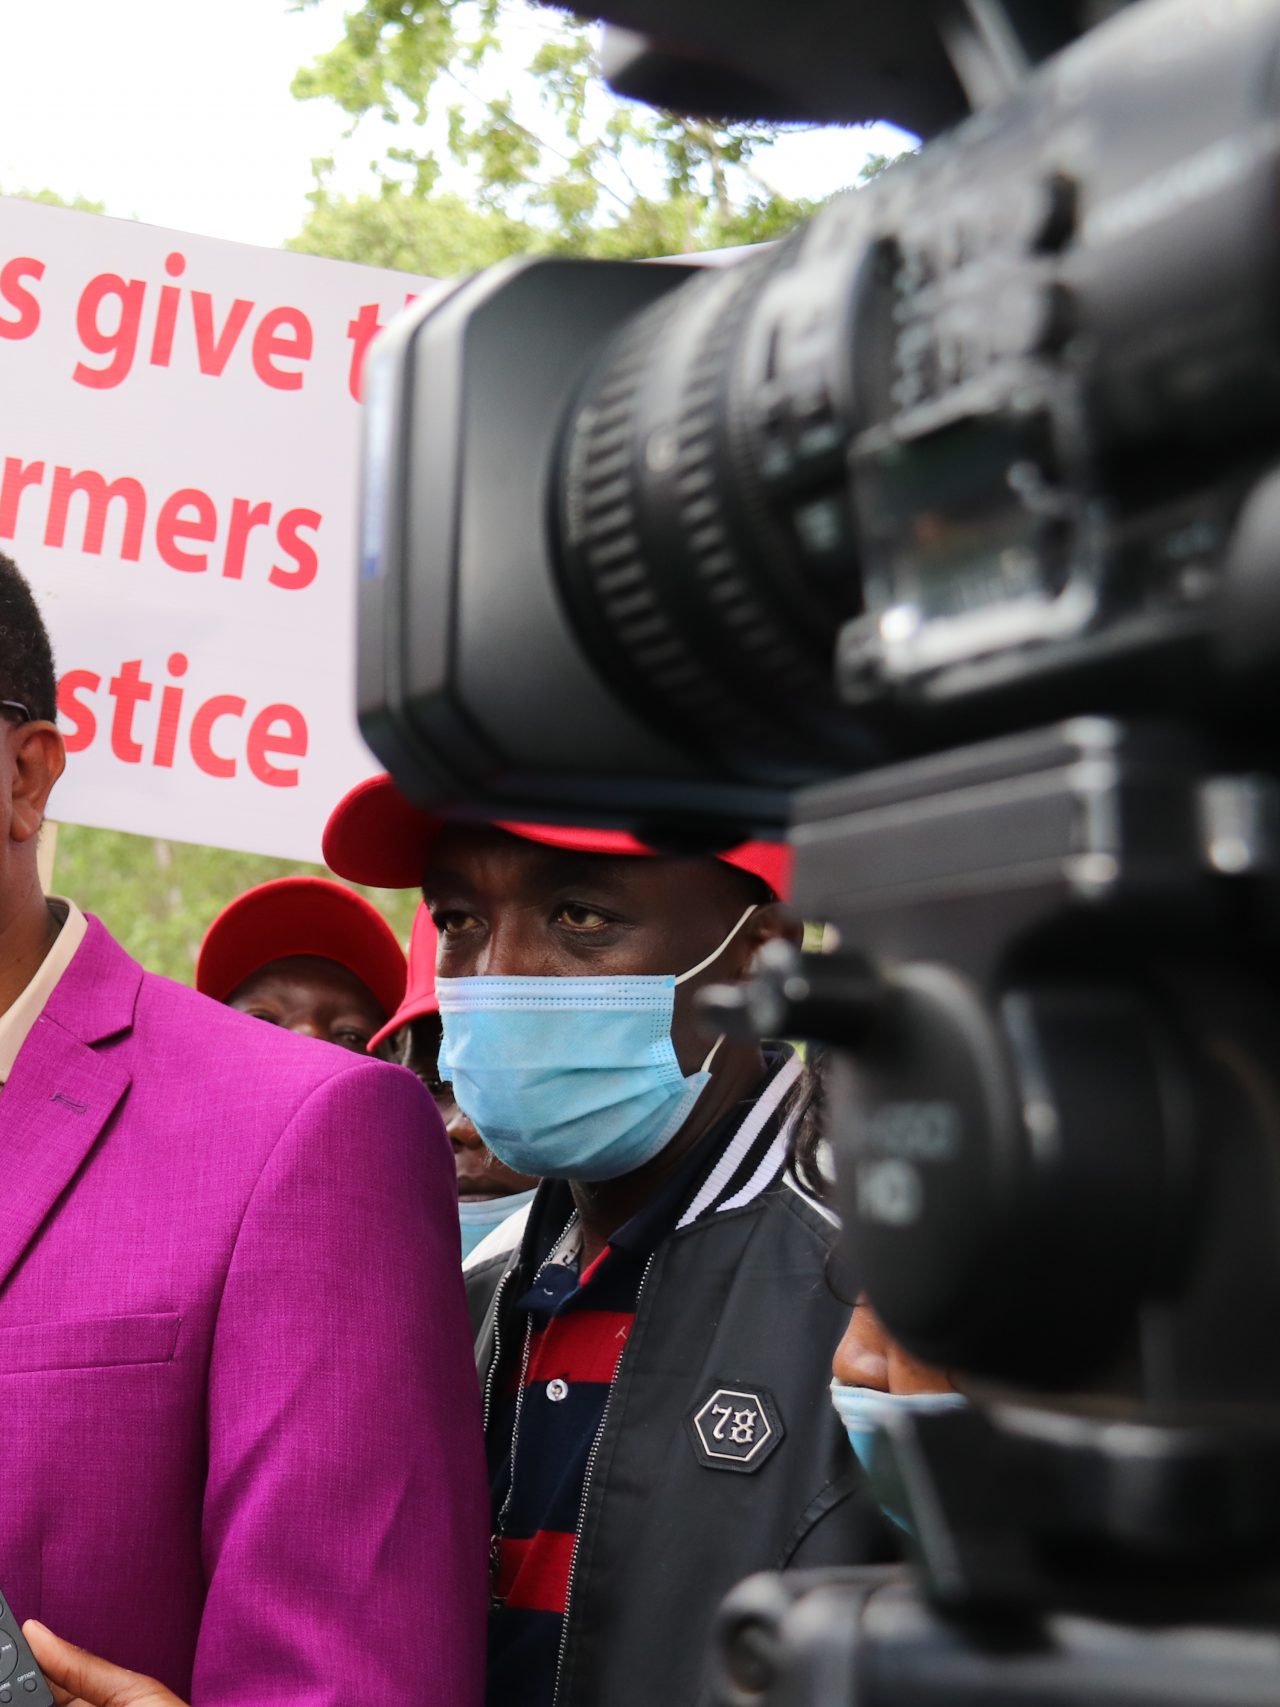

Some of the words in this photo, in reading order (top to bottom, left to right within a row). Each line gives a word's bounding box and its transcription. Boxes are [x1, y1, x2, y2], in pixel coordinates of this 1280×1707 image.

[72, 251, 315, 390] give
[55, 651, 310, 788] stice
[711, 1403, 758, 1444] 78
